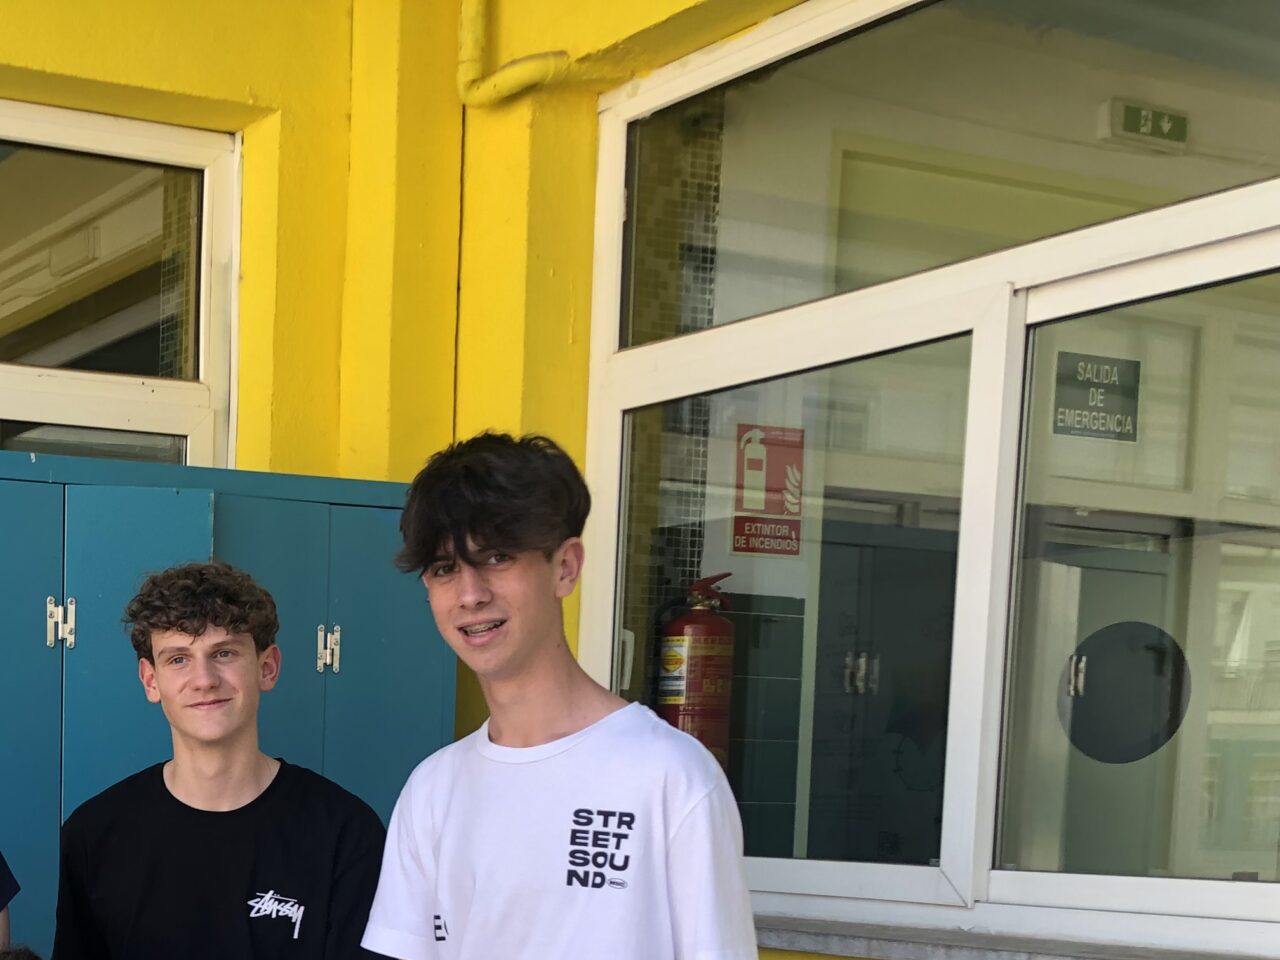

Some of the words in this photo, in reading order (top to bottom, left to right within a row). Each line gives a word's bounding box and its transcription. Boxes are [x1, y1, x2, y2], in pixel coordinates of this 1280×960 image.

[1077, 361, 1119, 385] SALIDA
[1088, 387, 1105, 407] DE
[1057, 408, 1133, 434] EMERGENCIA
[744, 522, 790, 537] EXTINTOR
[734, 535, 747, 548] DE
[749, 537, 798, 551] INCENDIOS
[572, 808, 636, 830] STR
[570, 828, 629, 850] EET
[568, 849, 630, 872] SOU
[566, 869, 606, 889] ND
